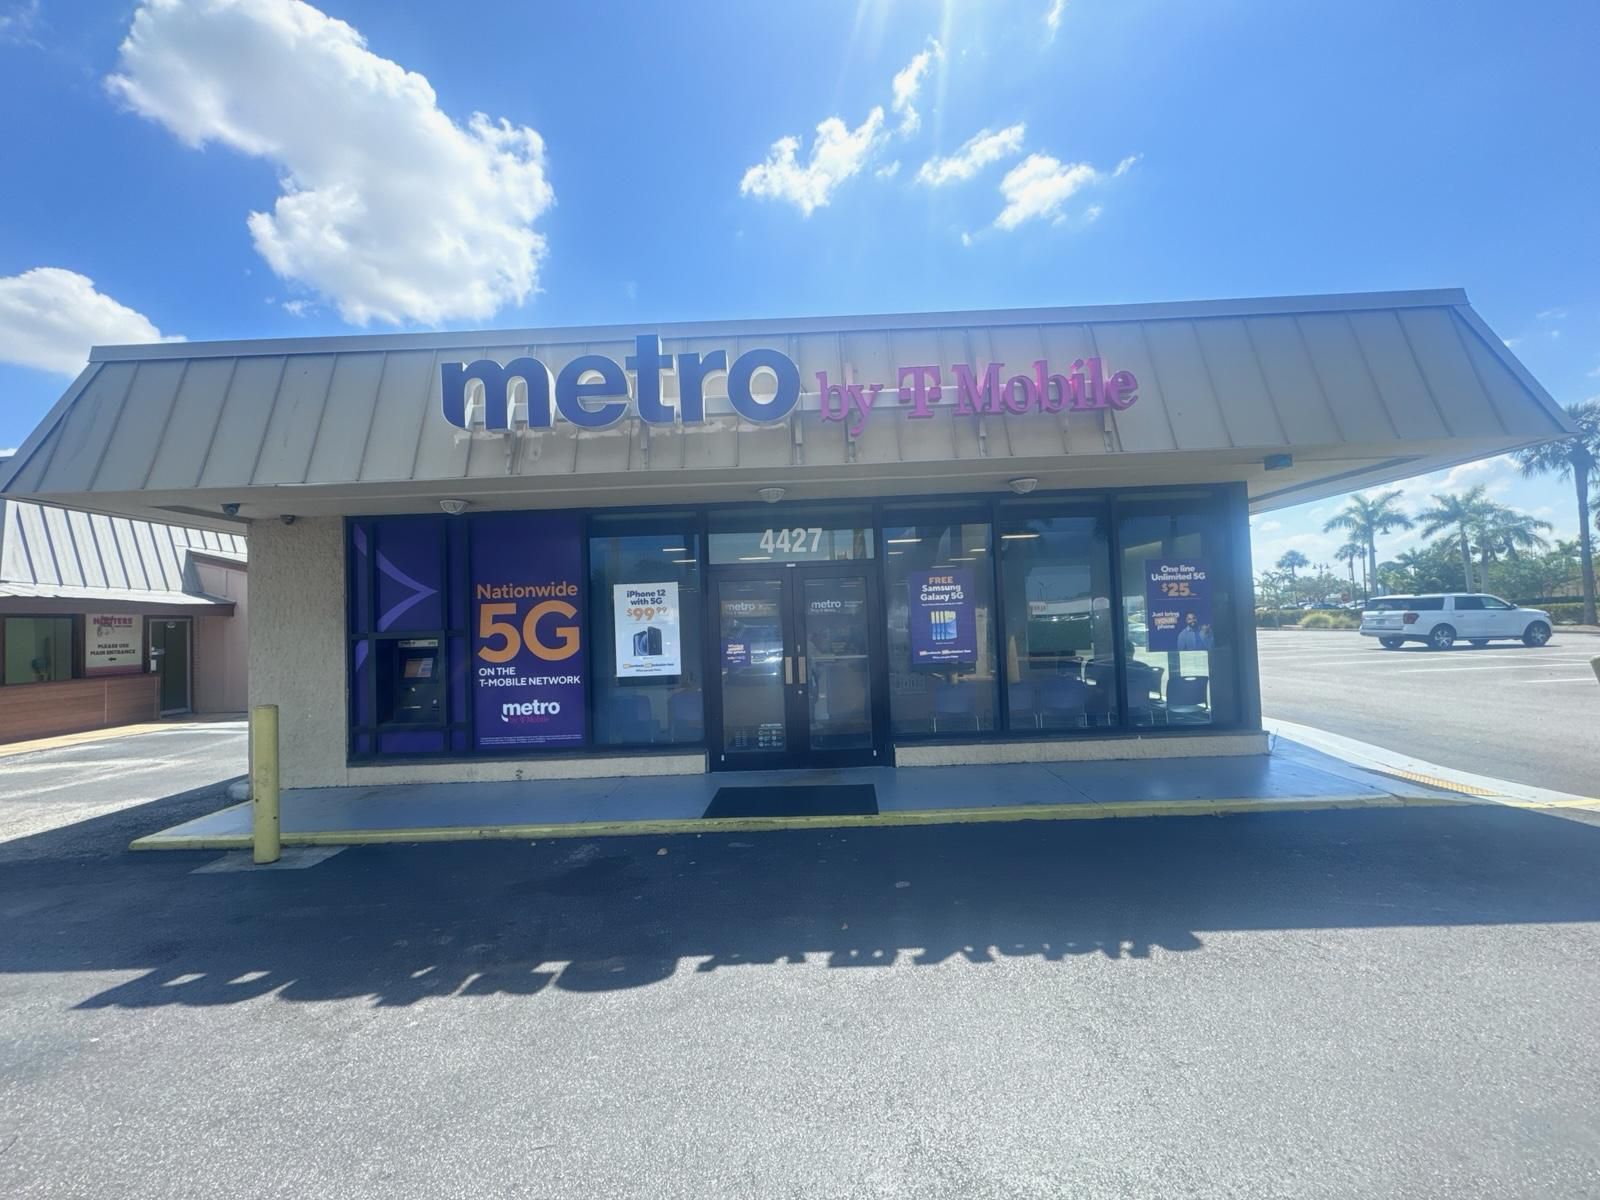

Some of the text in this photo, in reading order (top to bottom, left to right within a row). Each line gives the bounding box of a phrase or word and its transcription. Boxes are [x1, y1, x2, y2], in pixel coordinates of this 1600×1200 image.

[441, 335, 801, 430] metro
[815, 370, 884, 437] by
[952, 356, 1138, 416] Mobile
[760, 527, 823, 553] 4427
[1160, 564, 1196, 573] One line
[928, 576, 954, 584] FREE
[1151, 572, 1206, 581] Unlimited 5G
[477, 581, 578, 599] Nationwide
[921, 584, 961, 592] Samsung
[1161, 582, 1190, 597] $25
[626, 589, 666, 598] iPhone 12
[920, 592, 964, 602] Galaxy 5G
[630, 597, 663, 606] with 5G
[811, 600, 841, 609] metro
[478, 600, 580, 663] 5G
[478, 666, 517, 676] ON THE
[479, 675, 581, 687] T-MOBILE NETWORK
[502, 699, 561, 718] metro
